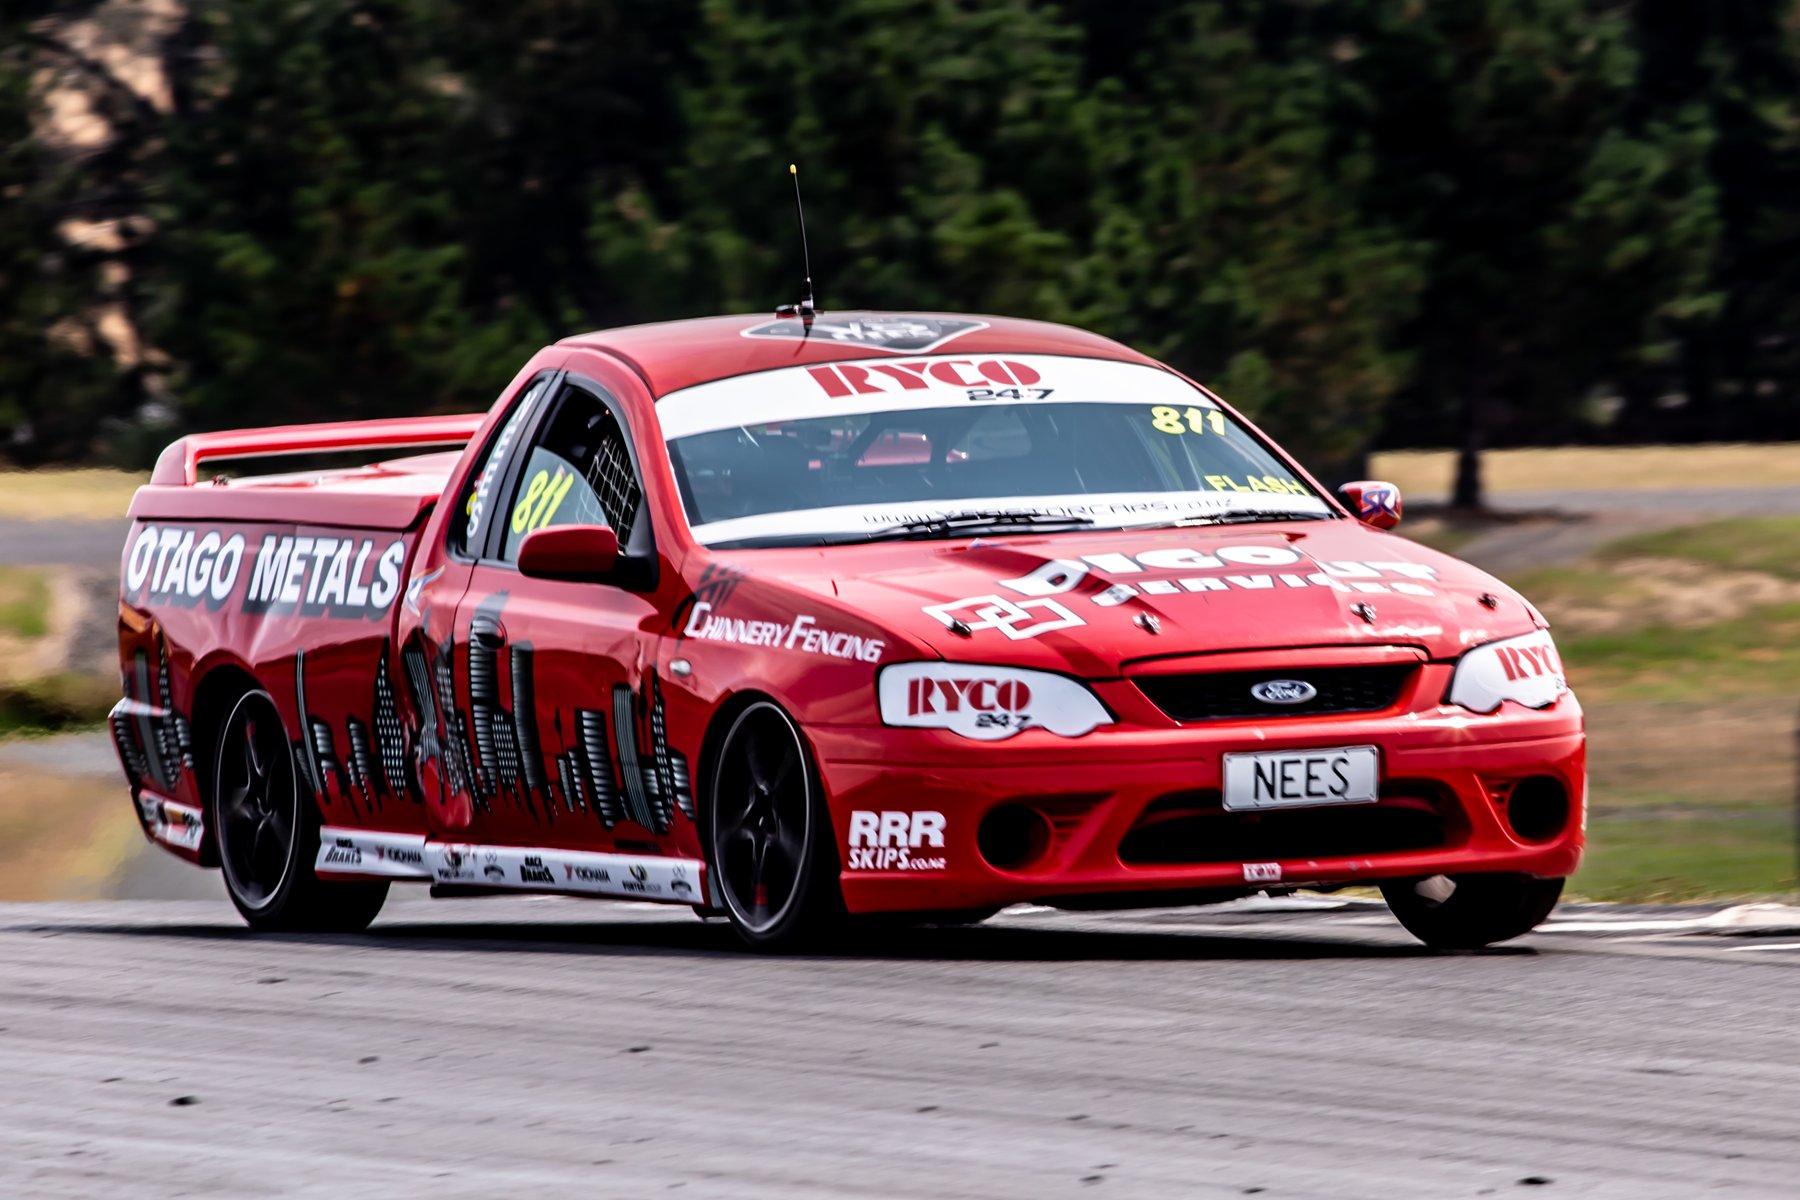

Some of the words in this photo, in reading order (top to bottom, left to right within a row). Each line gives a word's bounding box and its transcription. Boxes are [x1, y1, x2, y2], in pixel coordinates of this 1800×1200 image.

[806, 360, 1041, 399] RYCO
[1151, 406, 1226, 436] 811
[511, 470, 575, 535] 811
[1204, 475, 1312, 497] FLASH
[127, 525, 246, 600] OTAGO
[248, 535, 406, 609] METALS
[1093, 573, 1437, 606] SERVICES
[683, 601, 790, 648] CHINNERY
[784, 614, 886, 664] FENCING
[1494, 644, 1560, 682] RYC
[907, 676, 1031, 716] RYCO
[1253, 756, 1350, 801] NEES
[848, 810, 947, 848] RRR
